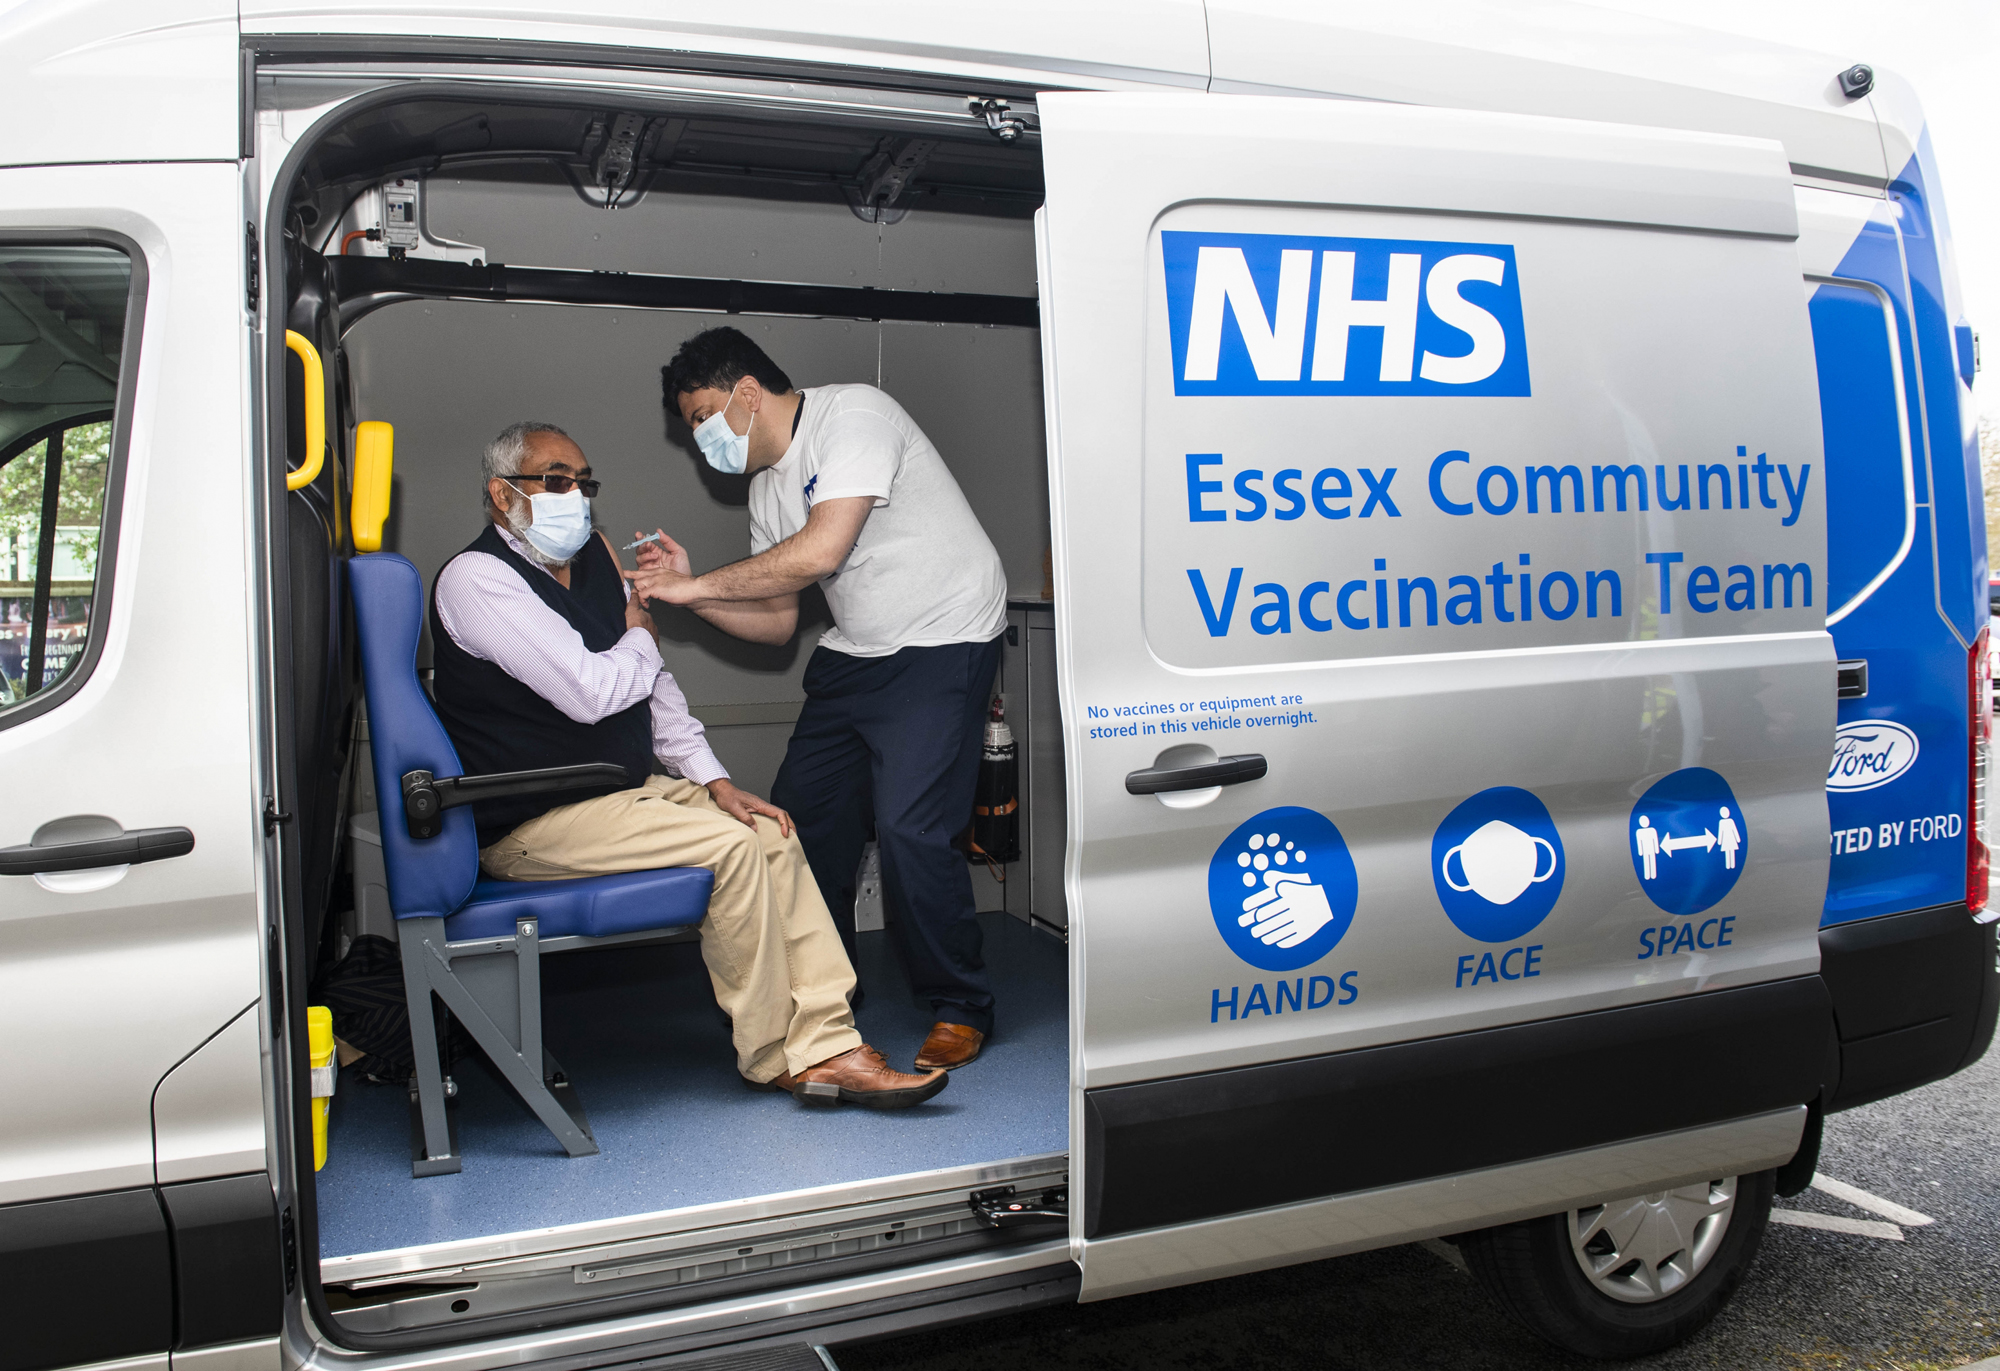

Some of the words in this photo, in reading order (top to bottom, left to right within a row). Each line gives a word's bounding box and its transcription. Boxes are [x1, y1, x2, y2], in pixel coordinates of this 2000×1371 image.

[1184, 246, 1506, 384] NHS
[1186, 453, 1402, 523] Essex
[1428, 446, 1811, 527] Community
[1186, 553, 1623, 637] Vaccination
[1645, 552, 1813, 615] Team
[21, 657, 67, 671] CME
[1088, 705, 1109, 718] No
[1114, 701, 1175, 717] vaccines
[1180, 703, 1195, 713] or
[1200, 696, 1277, 713] equipment
[1281, 694, 1303, 706] are
[1090, 722, 1138, 739] stored
[1143, 721, 1156, 735] in
[1161, 719, 1187, 733] this
[1192, 715, 1242, 731] vehicle
[1246, 711, 1318, 728] overnight.
[1828, 734, 1895, 778] Ford
[1878, 821, 1904, 849] BY
[1910, 813, 1962, 844] FORD
[1637, 916, 1736, 959] SPACE
[1455, 945, 1543, 988] FACE
[1210, 971, 1358, 1023] HANDS
